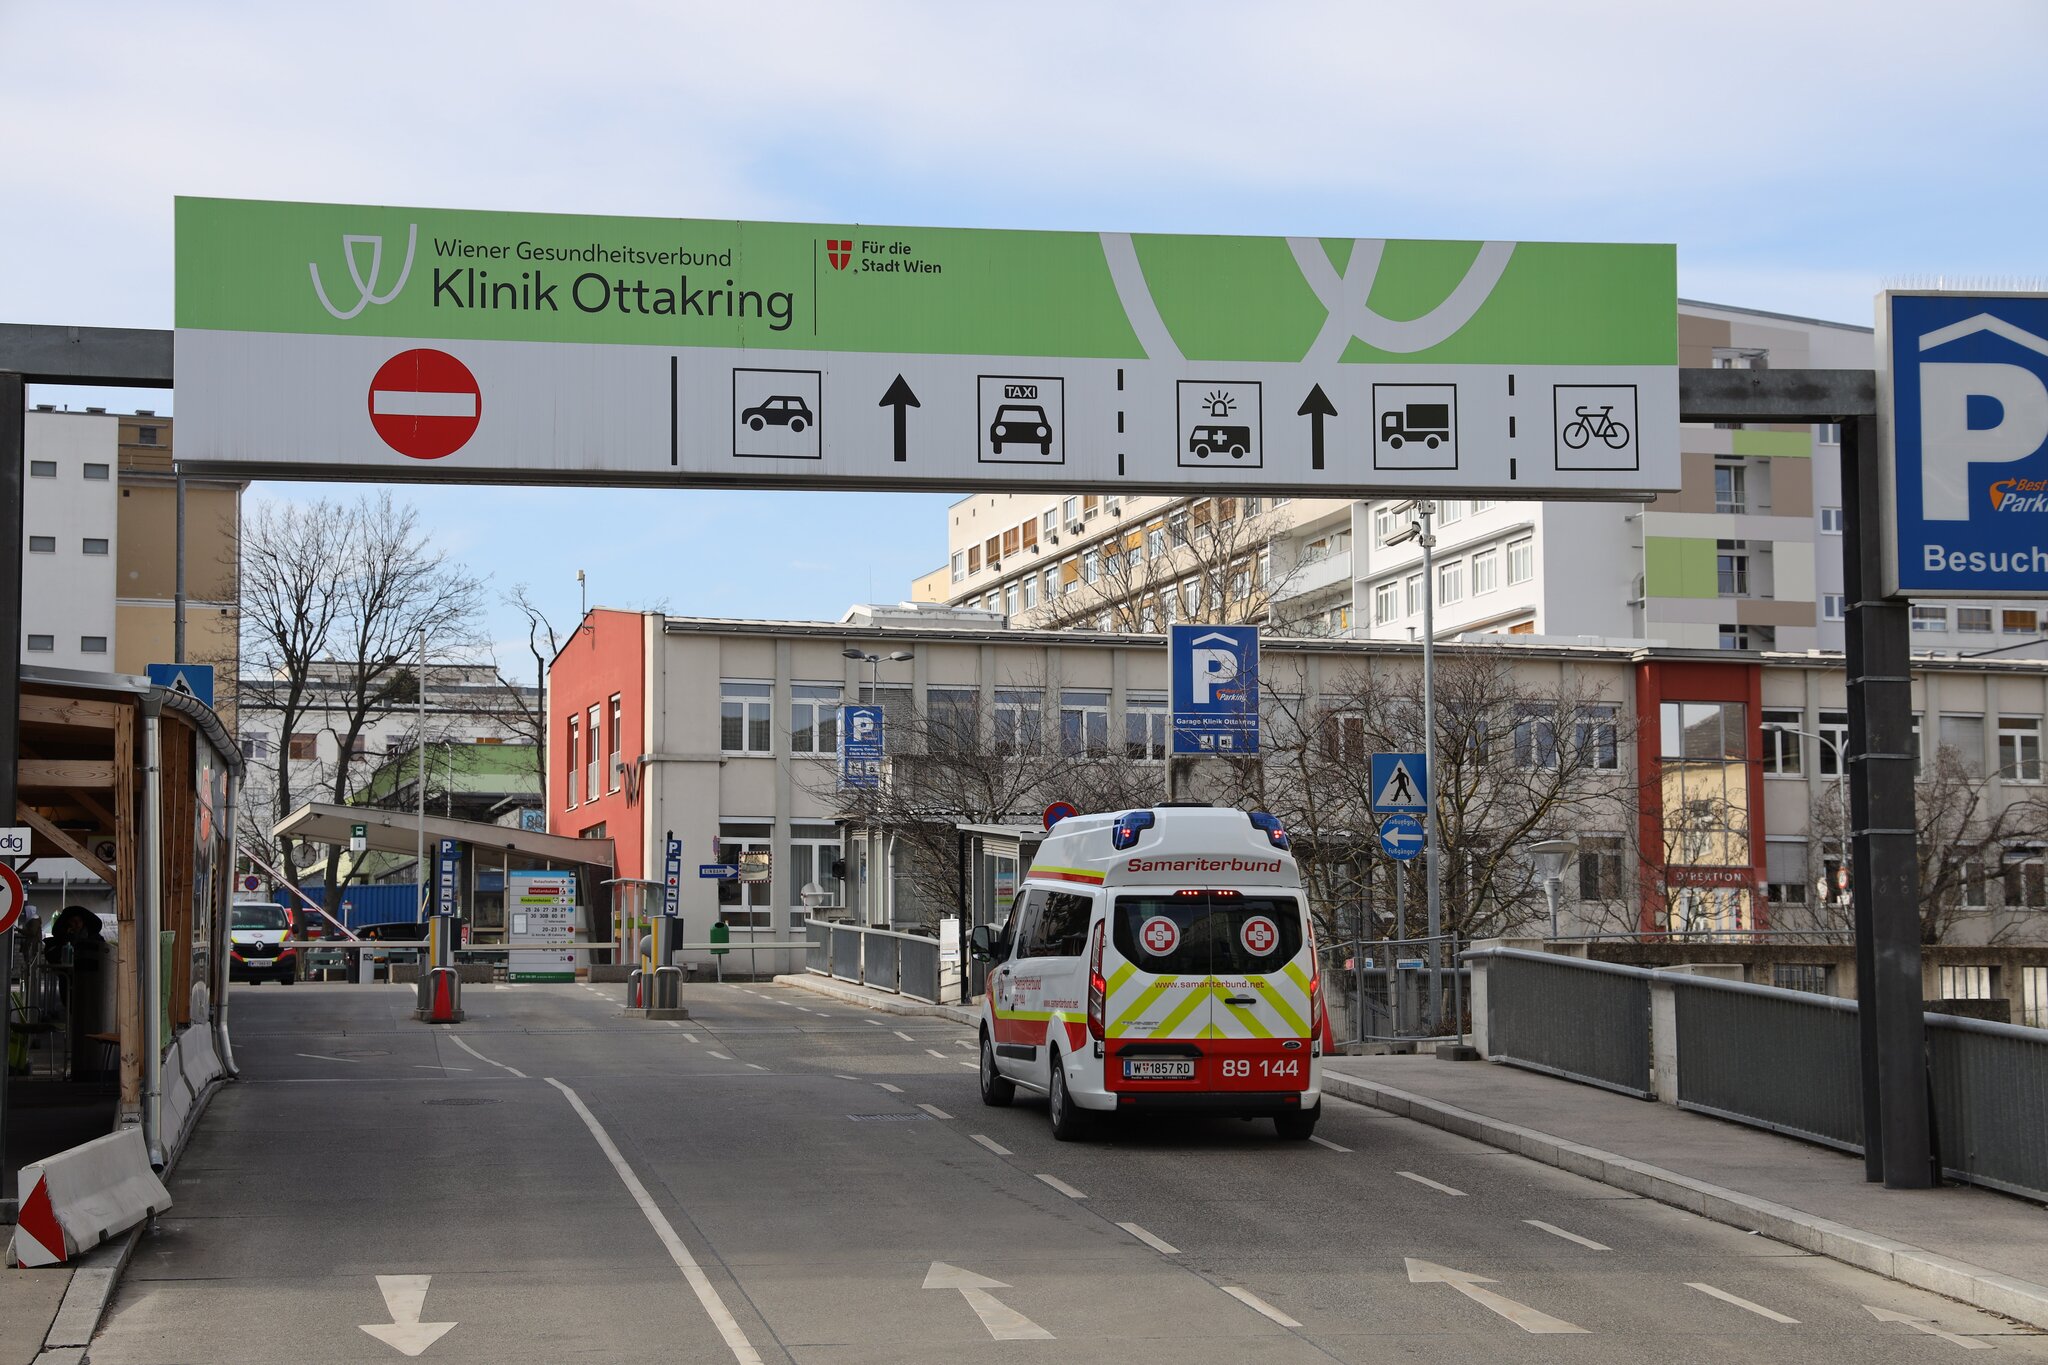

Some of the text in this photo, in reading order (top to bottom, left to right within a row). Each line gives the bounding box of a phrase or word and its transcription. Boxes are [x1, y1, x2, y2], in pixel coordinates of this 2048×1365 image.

[434, 238, 731, 267] Wiener Gesundheitsverbund
[861, 240, 911, 255] Für die
[861, 258, 942, 274] Stadt Wien
[433, 267, 794, 331] Klinik Ottakring
[1005, 386, 1036, 398] TAXI
[1919, 362, 2048, 521] P
[2015, 479, 2046, 491] Best
[1192, 648, 1238, 704] P
[853, 716, 874, 741] P
[442, 841, 452, 853] P
[668, 842, 678, 853] P
[1388, 847, 1416, 855] Fußgänger
[1127, 858, 1282, 873] Samariterbund
[1676, 872, 1742, 881] DIREKTION
[1155, 980, 1265, 989] www.samariterbund.net
[1133, 1063, 1190, 1074] W 1857 RD
[1222, 1059, 1299, 1077] 89 144
